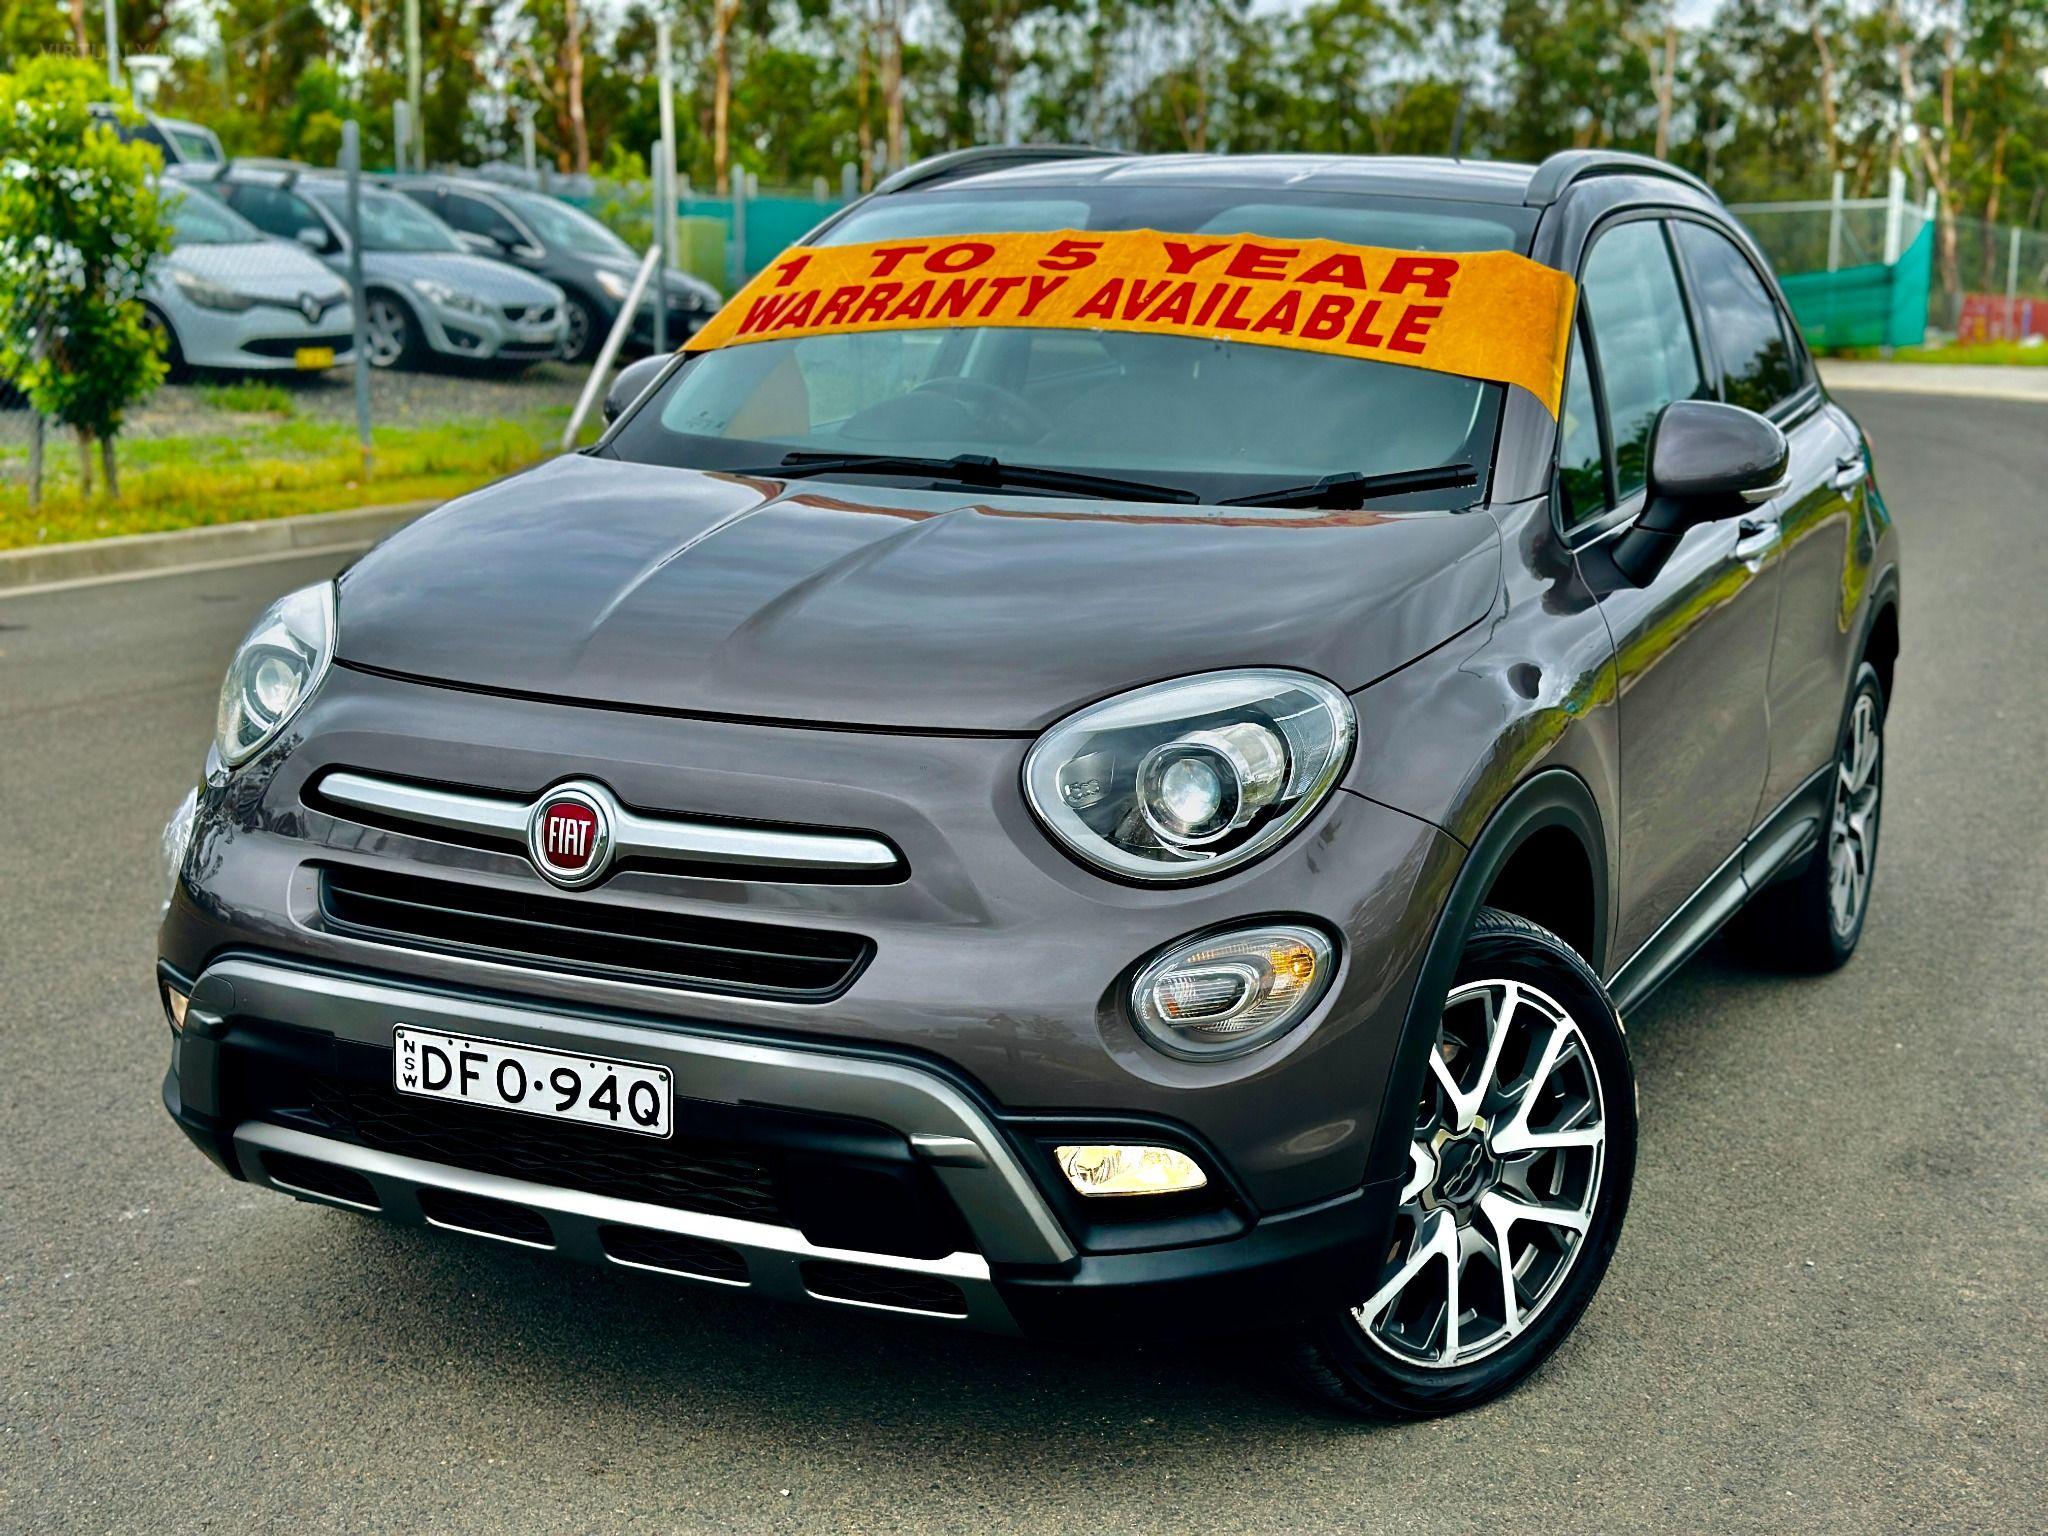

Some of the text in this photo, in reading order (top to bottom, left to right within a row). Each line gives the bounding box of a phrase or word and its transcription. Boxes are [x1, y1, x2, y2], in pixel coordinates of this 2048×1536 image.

[775, 239, 1460, 298] 1 TO 5 YEAR
[736, 275, 1445, 355] WARRANTY AVAILABLE
[548, 816, 592, 857] FIAT
[402, 1039, 418, 1088] NSW
